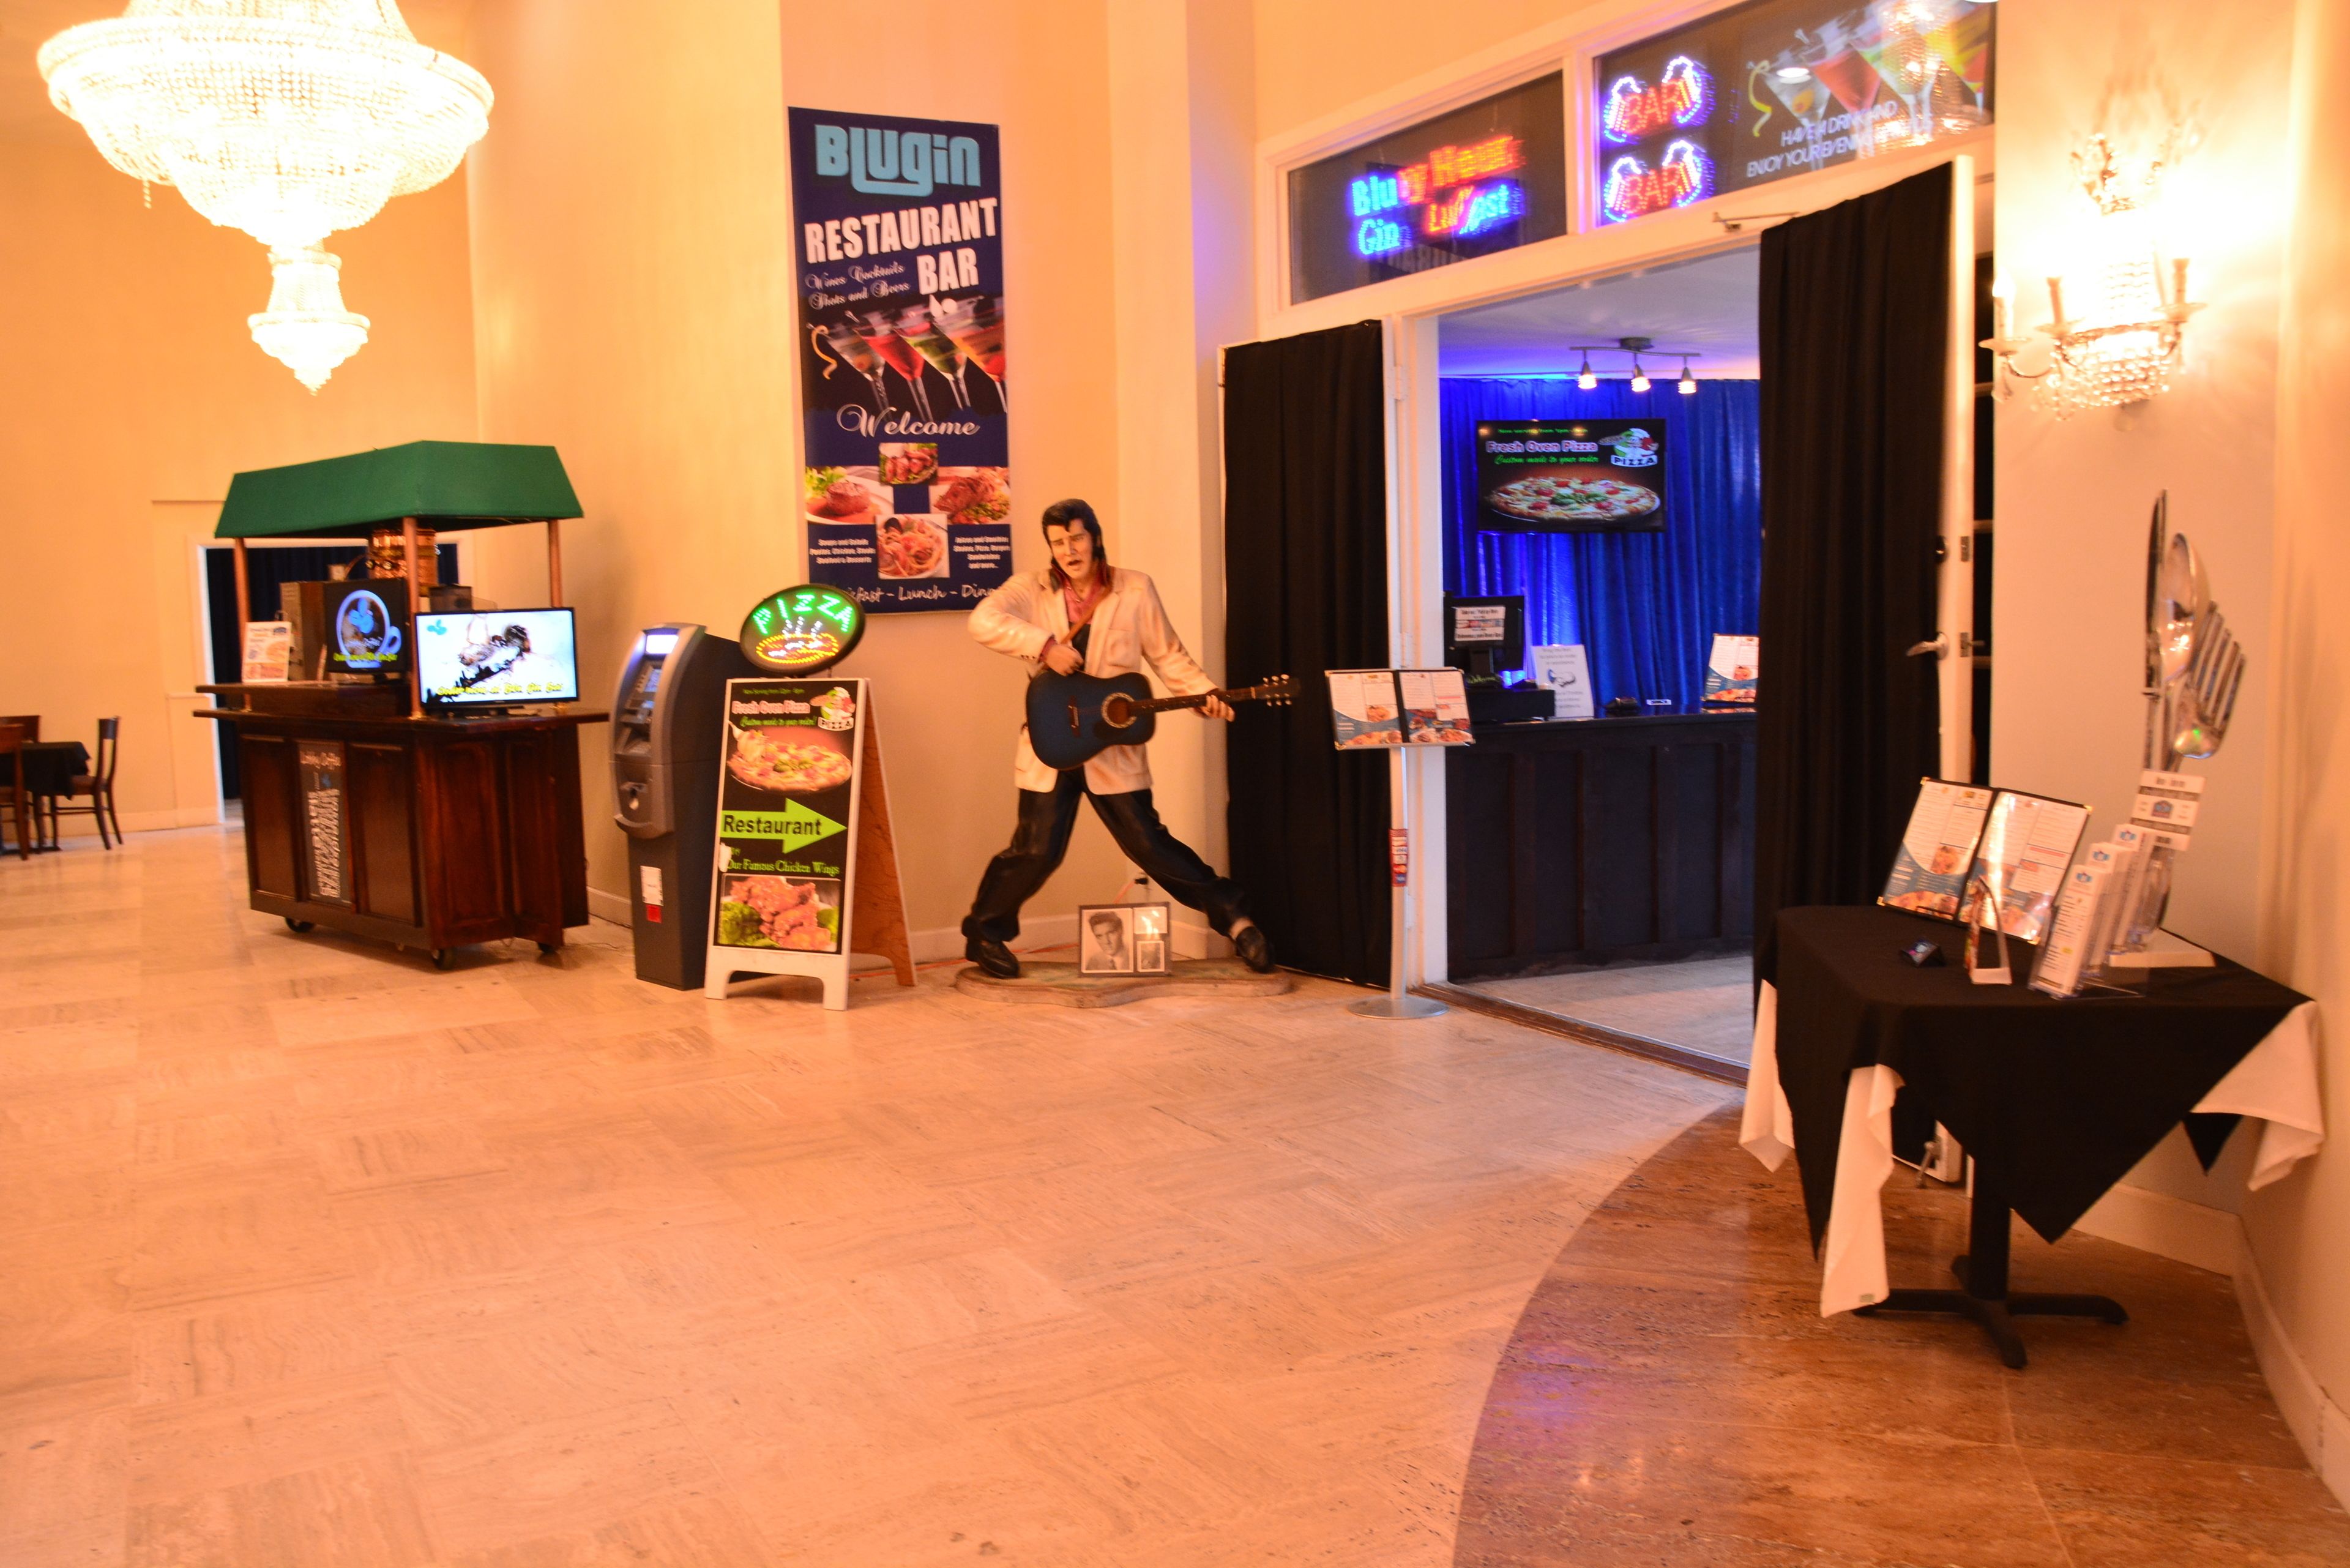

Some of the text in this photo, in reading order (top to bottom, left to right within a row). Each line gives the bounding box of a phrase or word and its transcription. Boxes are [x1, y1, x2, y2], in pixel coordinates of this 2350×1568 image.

[1625, 80, 1684, 133] BAR
[1780, 125, 1816, 147] HAVE
[1746, 153, 1783, 178] ENJOY
[1625, 163, 1684, 213] BAR
[804, 196, 998, 264] RESTAURANT
[805, 261, 905, 290] Wines Cocktails
[917, 248, 979, 295] BAR
[808, 280, 911, 310] Shots and Beers
[836, 404, 980, 438] Welcome
[1485, 440, 1598, 453] Fresh Oven Pizza
[1613, 456, 1656, 466] PIZZA
[898, 584, 947, 602] Lunch
[752, 592, 854, 635] PIZZA
[722, 814, 822, 836] Restaurant
[742, 858, 775, 872] Famous
[775, 859, 811, 873] Chicken
[811, 861, 840, 877] Wings
